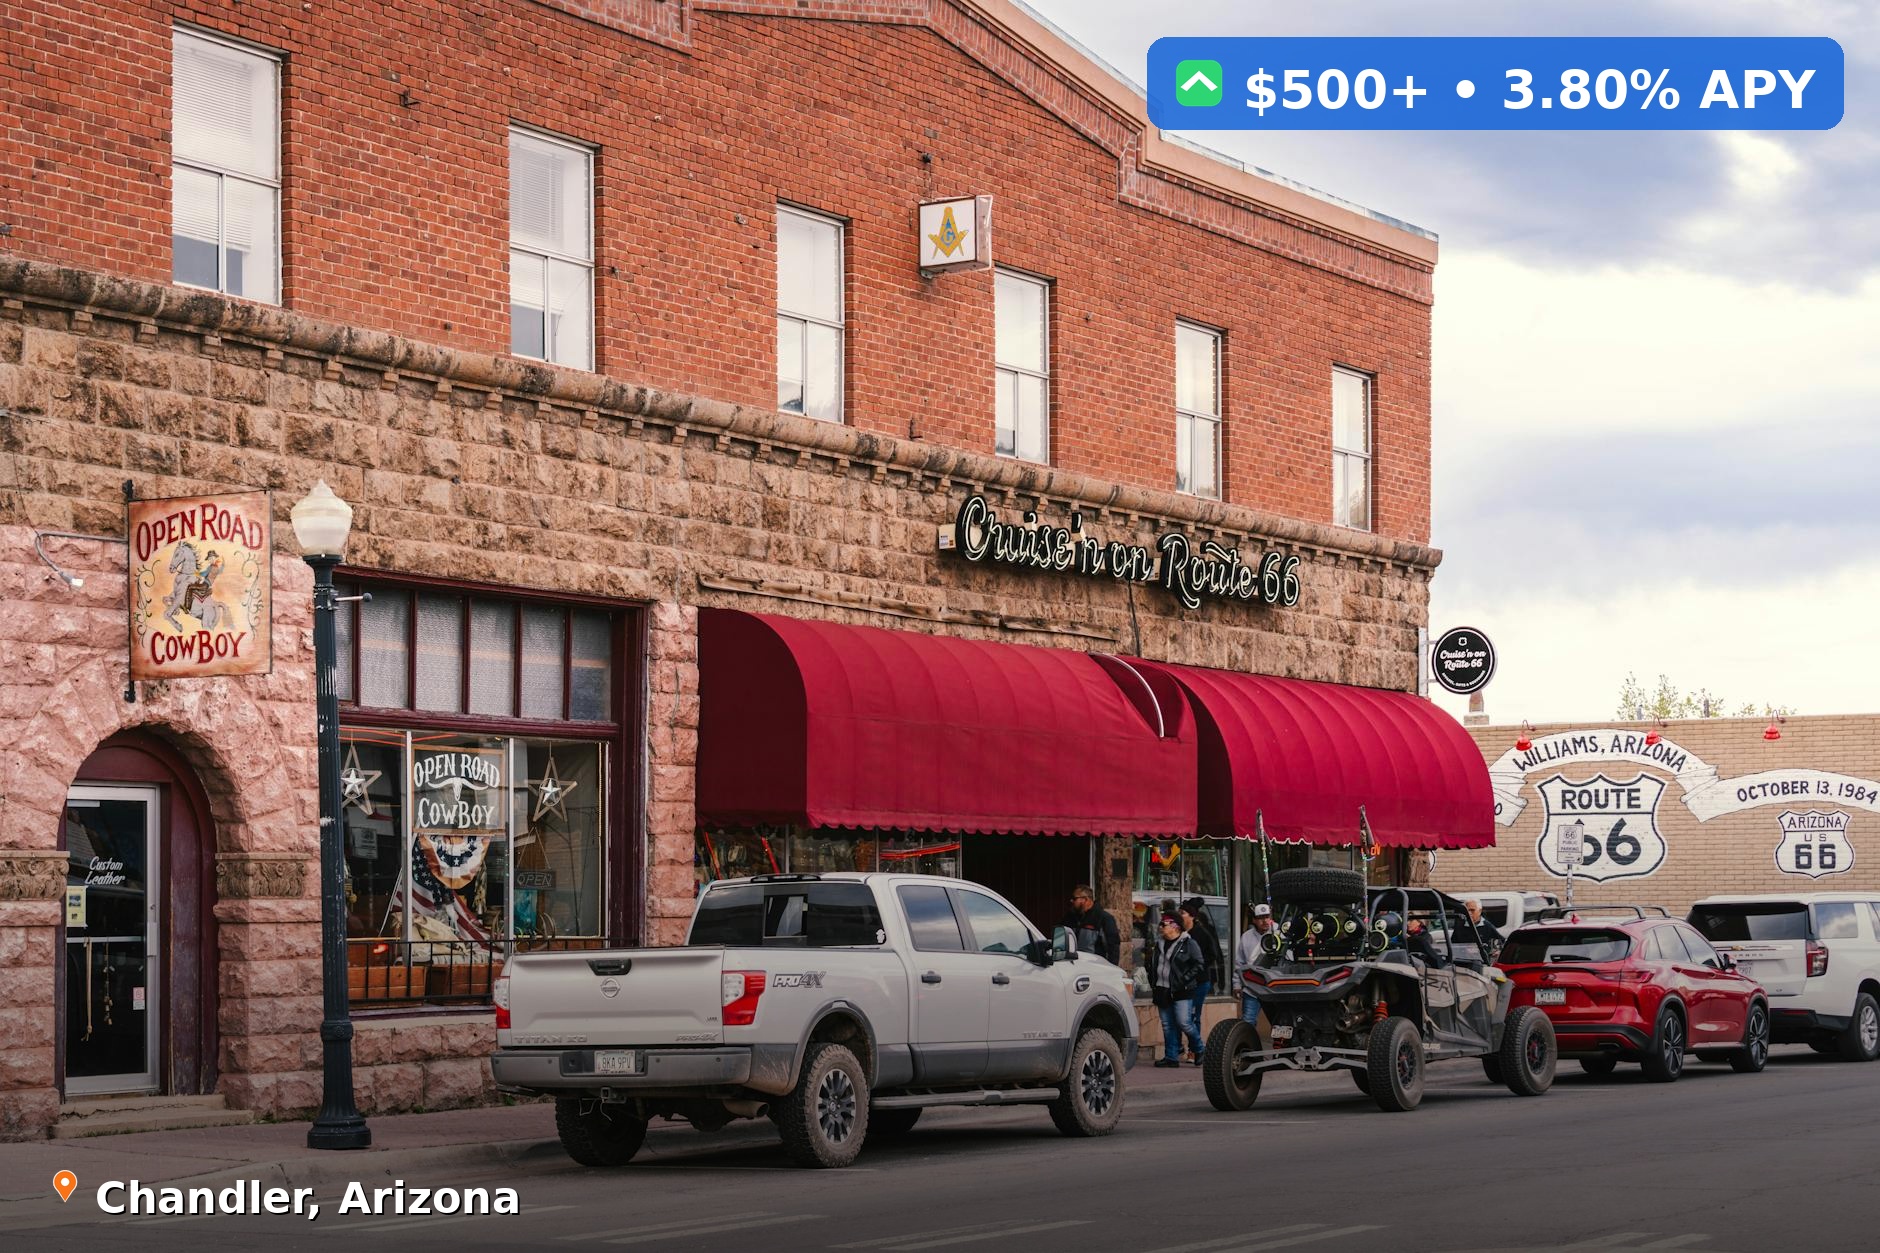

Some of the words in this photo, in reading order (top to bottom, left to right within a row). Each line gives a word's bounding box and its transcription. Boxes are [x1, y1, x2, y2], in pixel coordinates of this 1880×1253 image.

[136, 508, 196, 562] OPEN
[200, 503, 263, 550] ROAD
[1110, 541, 1152, 581] on
[1158, 533, 1256, 610] Route
[1260, 552, 1300, 607] 66
[1444, 660, 1470, 671] Route
[1470, 658, 1483, 668] 66
[1474, 650, 1486, 658] on
[1512, 735, 1605, 772] WILLIAMS,
[1610, 734, 1687, 772] ARIZONA
[413, 753, 456, 787] OPEN
[460, 753, 500, 788] ROAD
[1561, 788, 1641, 810] ROUTE
[1737, 781, 1809, 802] OCTOBER
[1838, 783, 1878, 804] 1984
[1787, 816, 1842, 829] ARIZONA
[89, 856, 123, 871] Custom
[1795, 844, 1836, 869] 66
[85, 871, 126, 885] Leather
[517, 874, 552, 887] OPEN
